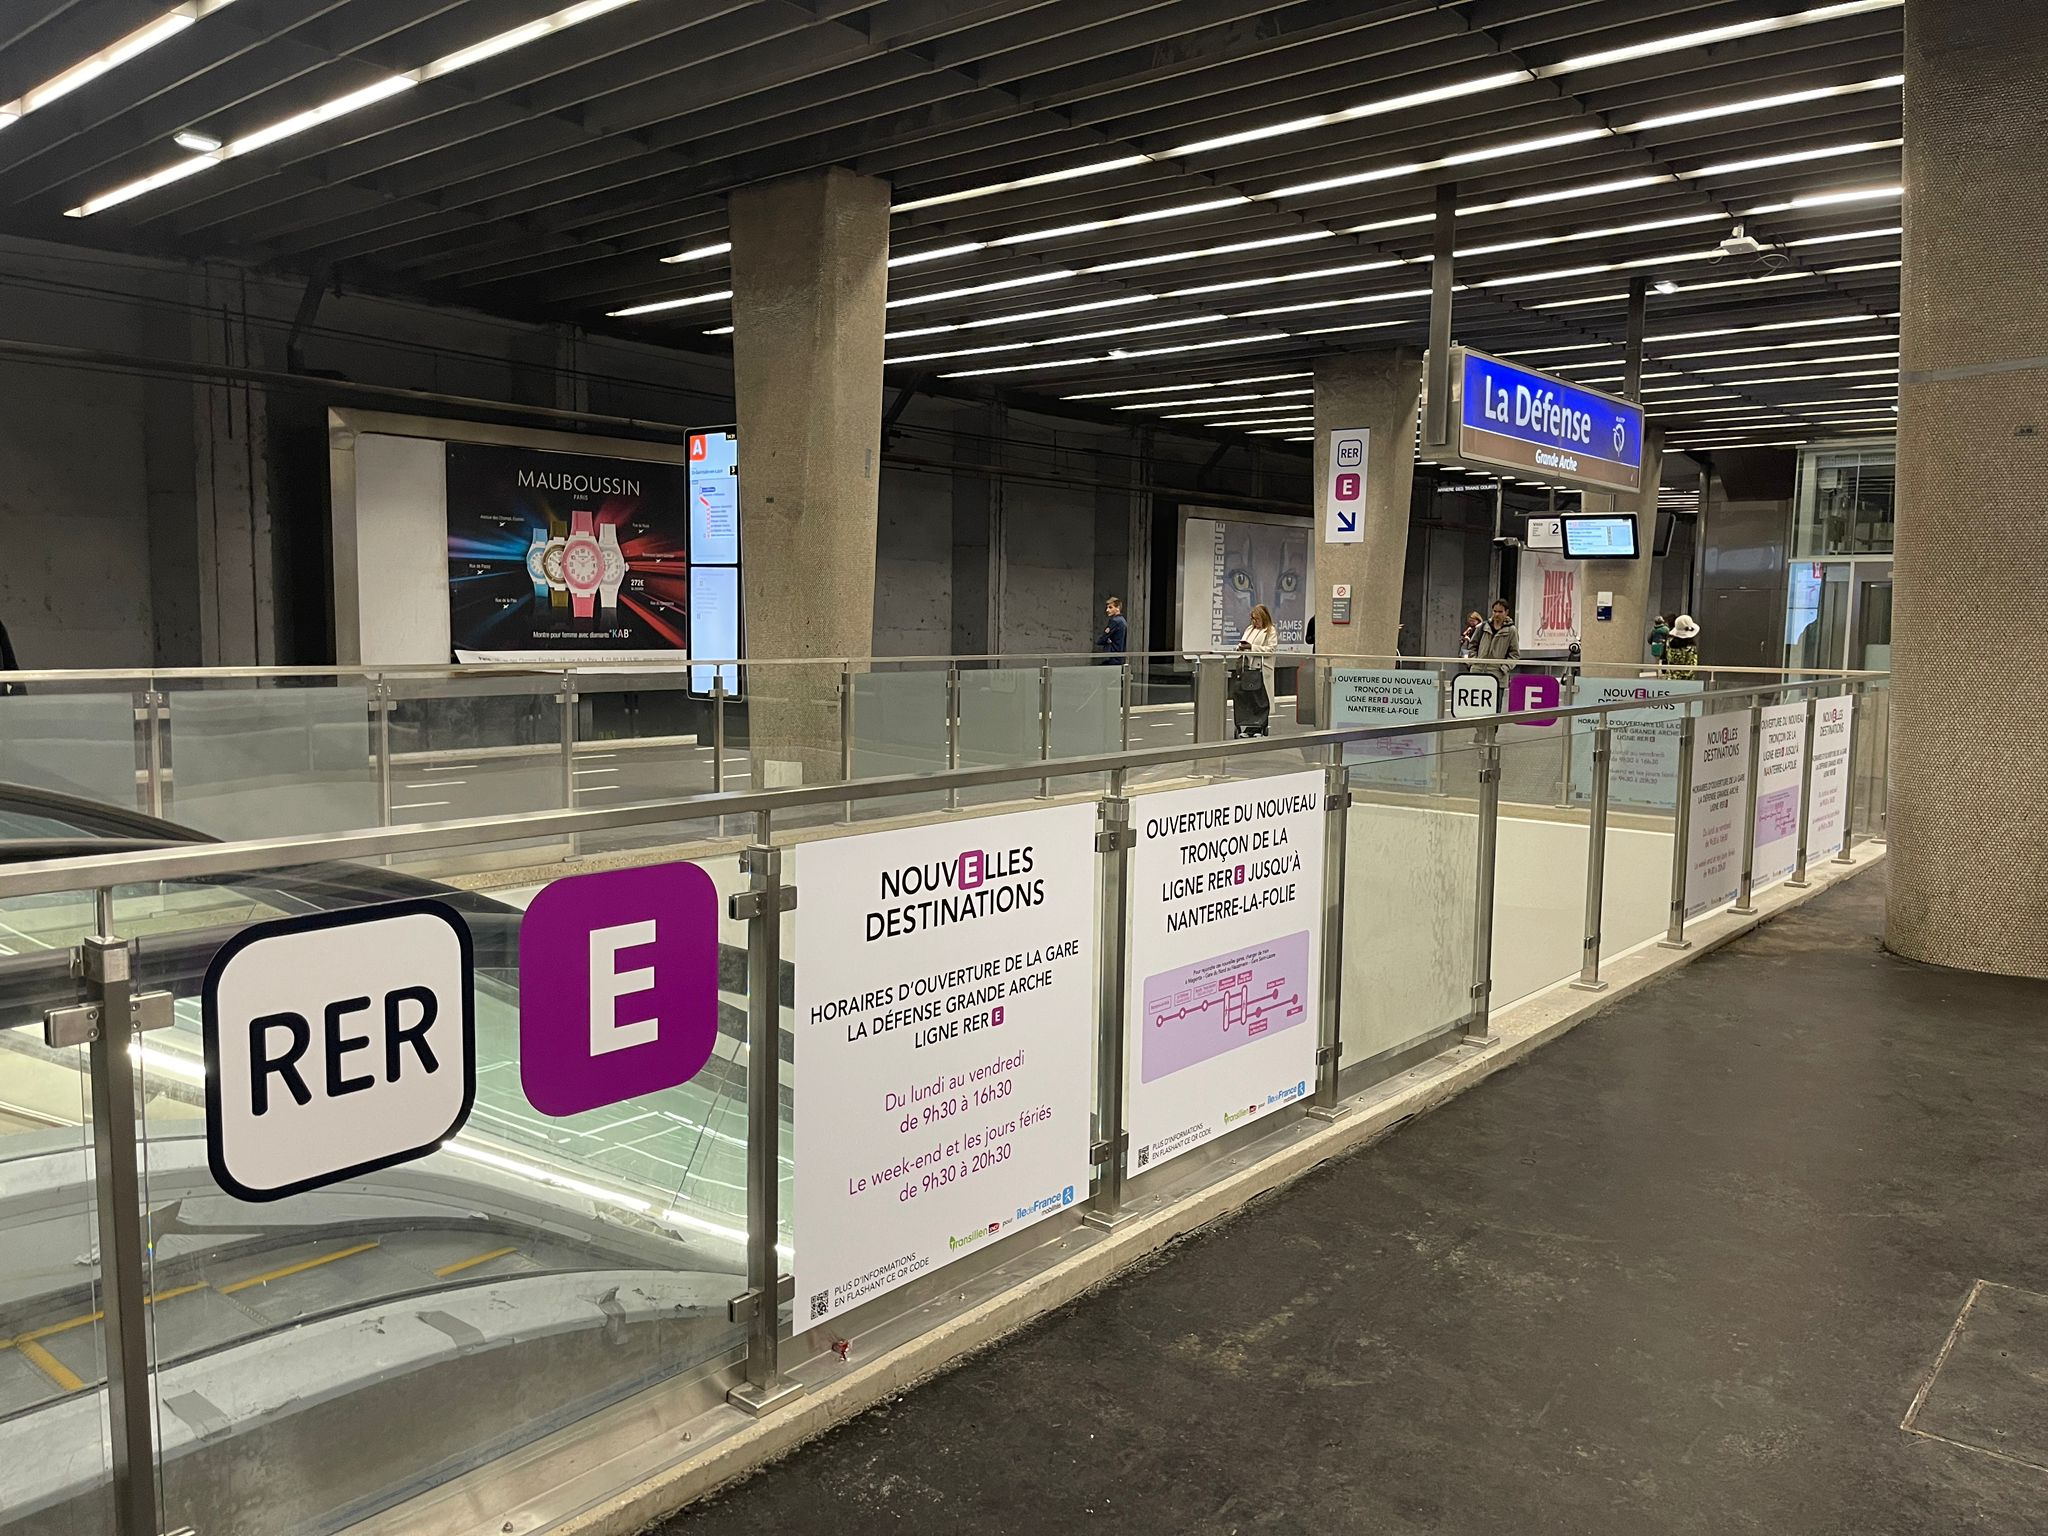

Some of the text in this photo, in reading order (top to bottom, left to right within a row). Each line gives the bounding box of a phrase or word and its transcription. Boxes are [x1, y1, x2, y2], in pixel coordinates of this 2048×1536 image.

[1484, 375, 1591, 444] La Défense
[692, 439, 703, 455] A
[1340, 448, 1359, 459] RER
[1535, 449, 1577, 471] Grande Arche
[518, 470, 640, 497] MAUBOUSSIN
[1343, 479, 1352, 495] E
[1552, 523, 1559, 534] 2
[1212, 522, 1226, 645] CINEMATHEQUE
[1279, 620, 1302, 630] JAMES
[1337, 675, 1380, 684] OUVERTURE
[1354, 686, 1390, 694] TRONÇON
[1603, 688, 1670, 699] NOUVELLES
[1345, 695, 1366, 703] LIGNE
[1390, 697, 1422, 705] JUSQU'À
[1347, 705, 1419, 715] NANTERRE-LA-FOLIE
[1458, 688, 1492, 707] RER
[1707, 727, 1738, 744] NOUVELLES
[1704, 743, 1739, 762] DESTINATIONS
[1146, 793, 1317, 839] OUVERTURE DU NOUVEAU
[1180, 827, 1288, 864] TRONÇON DE LA
[881, 846, 1034, 900] NOUVELLES
[1162, 875, 1204, 902] LIGNE
[1208, 869, 1233, 891] RER
[1248, 850, 1301, 882] JUSQU'À
[866, 879, 1045, 942] DESTINATIONS
[1167, 884, 1296, 933] NANTERRE-LA-FOLIE
[589, 919, 659, 1058] E
[811, 940, 1079, 1025] HORAIRES D'OUVERTURE DE LA GARE
[847, 970, 1052, 1042] LA DÉFENSE GRANDE ARCHE
[915, 1020, 958, 1048] LIGNE
[963, 1012, 989, 1034] RER
[249, 985, 439, 1117] RER
[885, 1050, 1025, 1111] Du lundi au vendredi
[900, 1079, 1012, 1133] de 9h30 à 16h30
[849, 1104, 1052, 1195] Le week-end et les jours fériés
[1152, 1123, 1204, 1150] PLUS D'INFORMATIONS
[1152, 1151, 1159, 1159] EN
[1160, 1140, 1184, 1155] FLASHANT
[1184, 1137, 1190, 1145] CE
[1199, 1128, 1211, 1138] CODE
[899, 1143, 1011, 1201] de 9h30 à 20h30
[1002, 1217, 1013, 1227] pour
[1041, 1203, 1061, 1216] mobilités
[834, 1252, 916, 1296] PLUS D'INFORMATIONS
[834, 1257, 929, 1307] EN FLASHANT CE QR CODE
